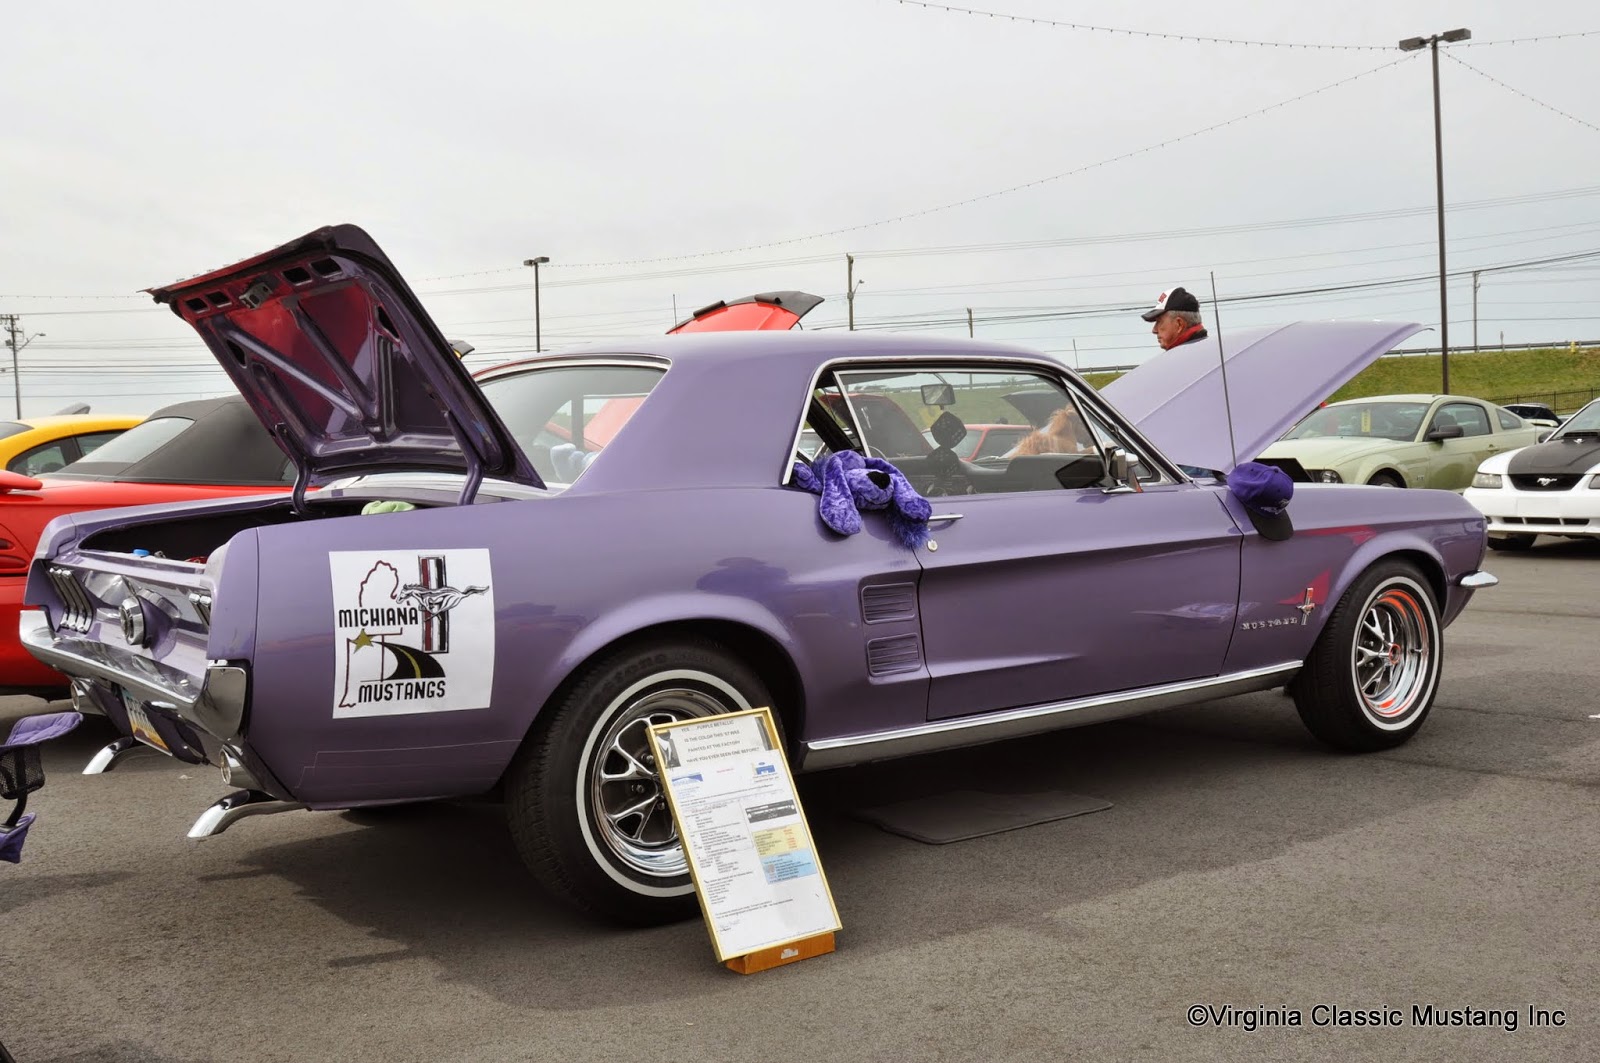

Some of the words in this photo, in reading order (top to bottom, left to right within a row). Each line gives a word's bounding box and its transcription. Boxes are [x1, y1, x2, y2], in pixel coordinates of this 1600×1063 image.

[338, 607, 419, 628] MICHIANA
[1242, 617, 1298, 630] MUSTANG
[358, 681, 446, 703] MUSTANGS
